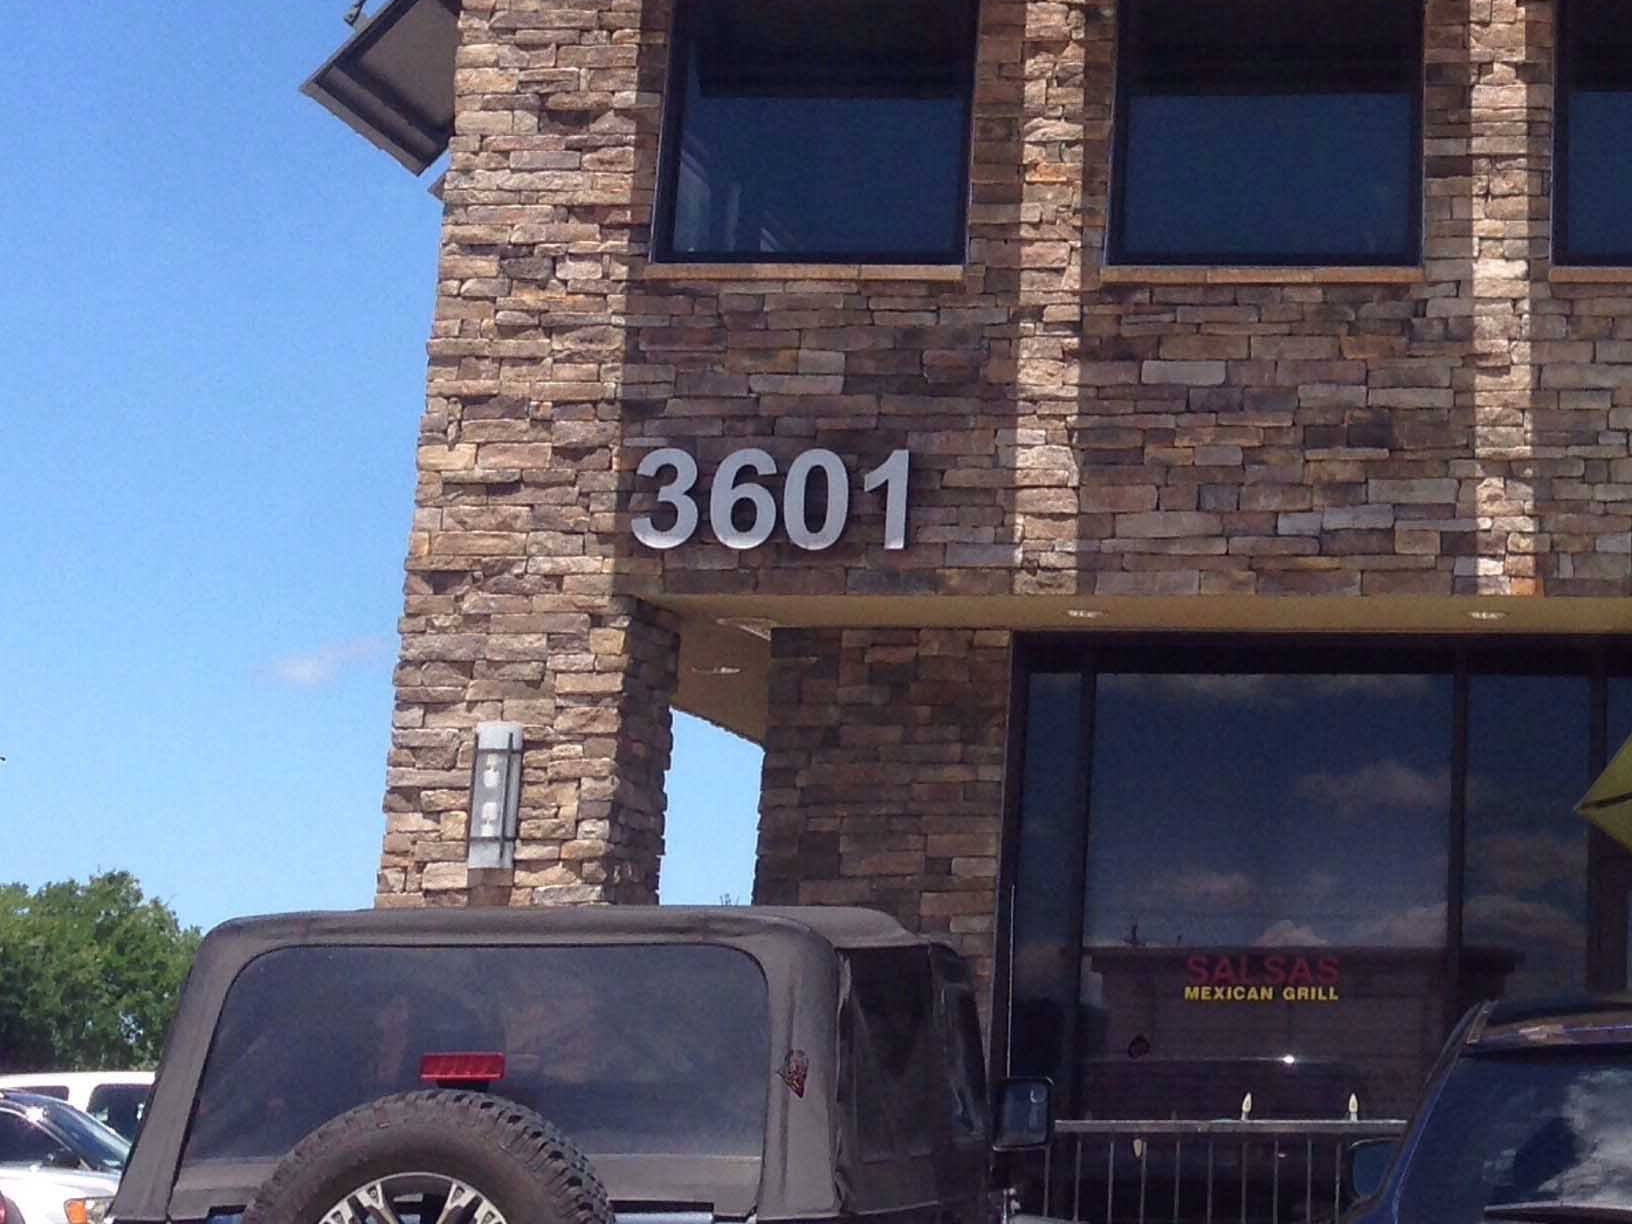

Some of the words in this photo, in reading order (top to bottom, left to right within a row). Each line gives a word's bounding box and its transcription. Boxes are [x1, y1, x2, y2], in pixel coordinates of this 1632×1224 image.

[631, 447, 910, 551] 3601
[1186, 954, 1341, 984] SALSAS
[1184, 986, 1273, 1001] MEXICAN
[1282, 986, 1339, 1001] GRILL
